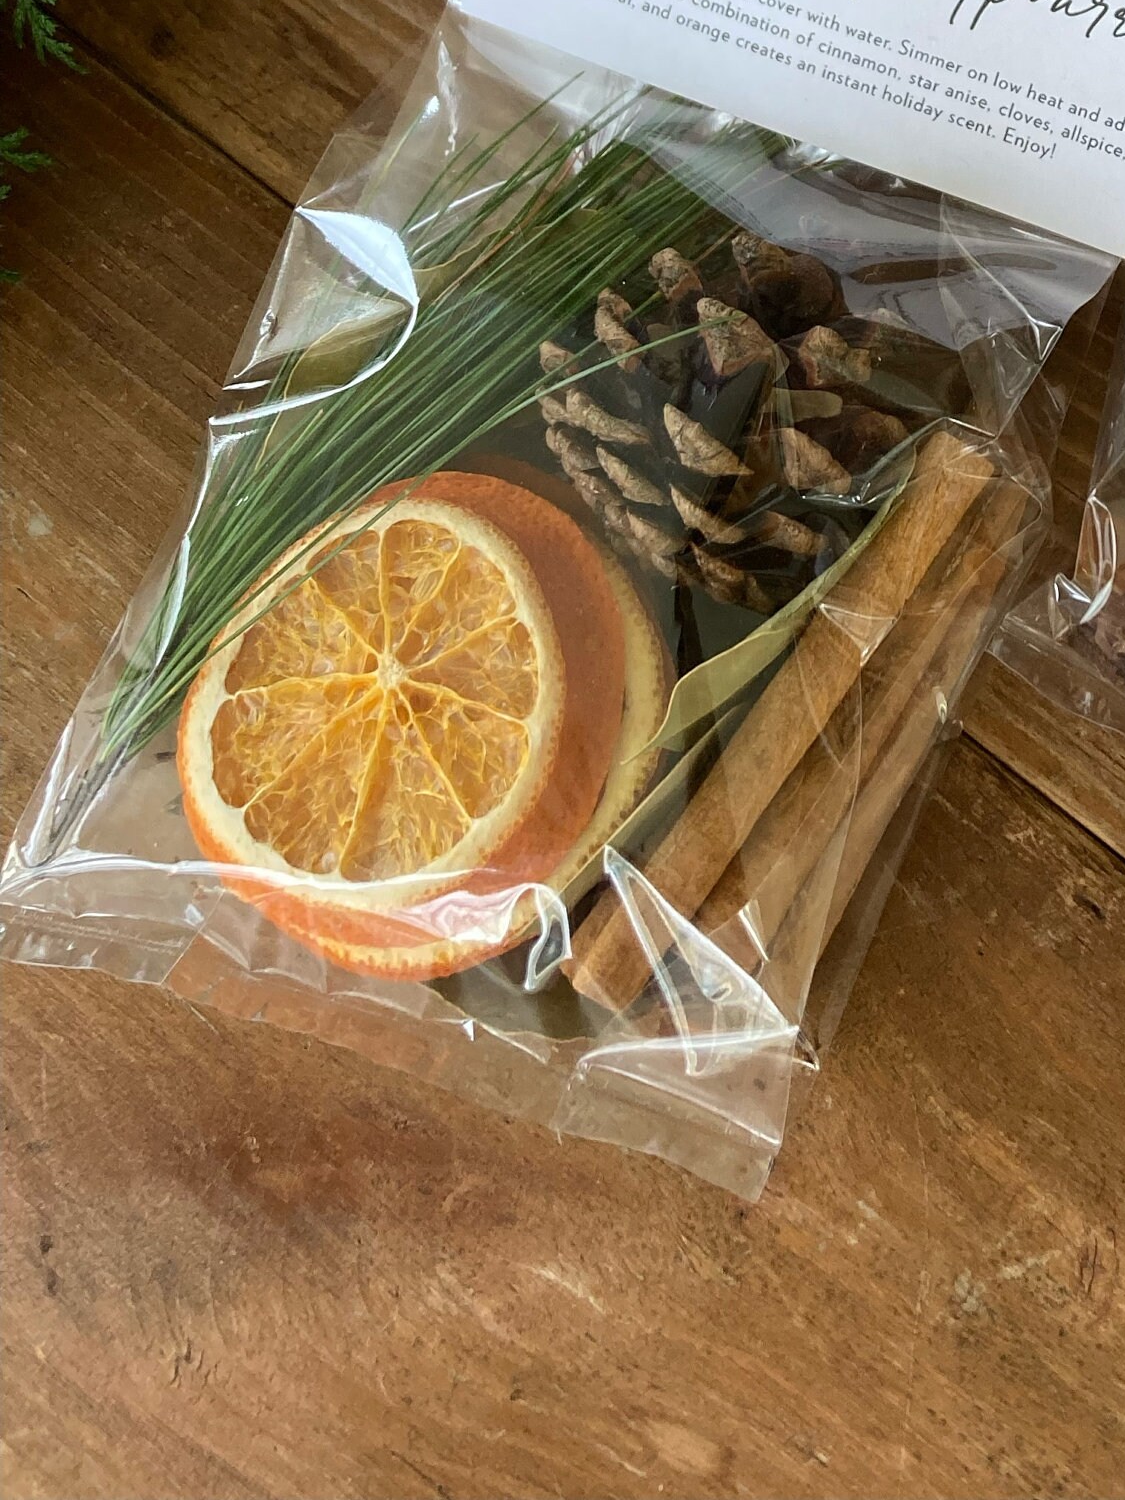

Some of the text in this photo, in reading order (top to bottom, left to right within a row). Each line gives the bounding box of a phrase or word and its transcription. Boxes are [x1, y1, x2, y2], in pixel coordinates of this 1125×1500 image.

[641, 2, 673, 20] and
[676, 14, 731, 43] orange
[735, 37, 793, 66] creates
[796, 59, 817, 75] an
[821, 64, 878, 97] instant
[881, 85, 944, 122] holiday
[947, 113, 997, 139] scent.
[1002, 125, 1057, 161] Enjoy!
[795, 31, 816, 48] of
[817, 41, 902, 81] cinnamon,
[908, 74, 941, 92] star
[944, 86, 991, 113] anise,
[998, 101, 1054, 135] cloves,
[1060, 124, 1125, 161] allspice,
[807, 11, 840, 32] with
[845, 25, 892, 51] water.
[897, 39, 963, 74] Simmer
[967, 68, 989, 84] on
[992, 71, 1023, 95] low
[1025, 82, 1065, 111] heat
[1067, 103, 1102, 123] and
